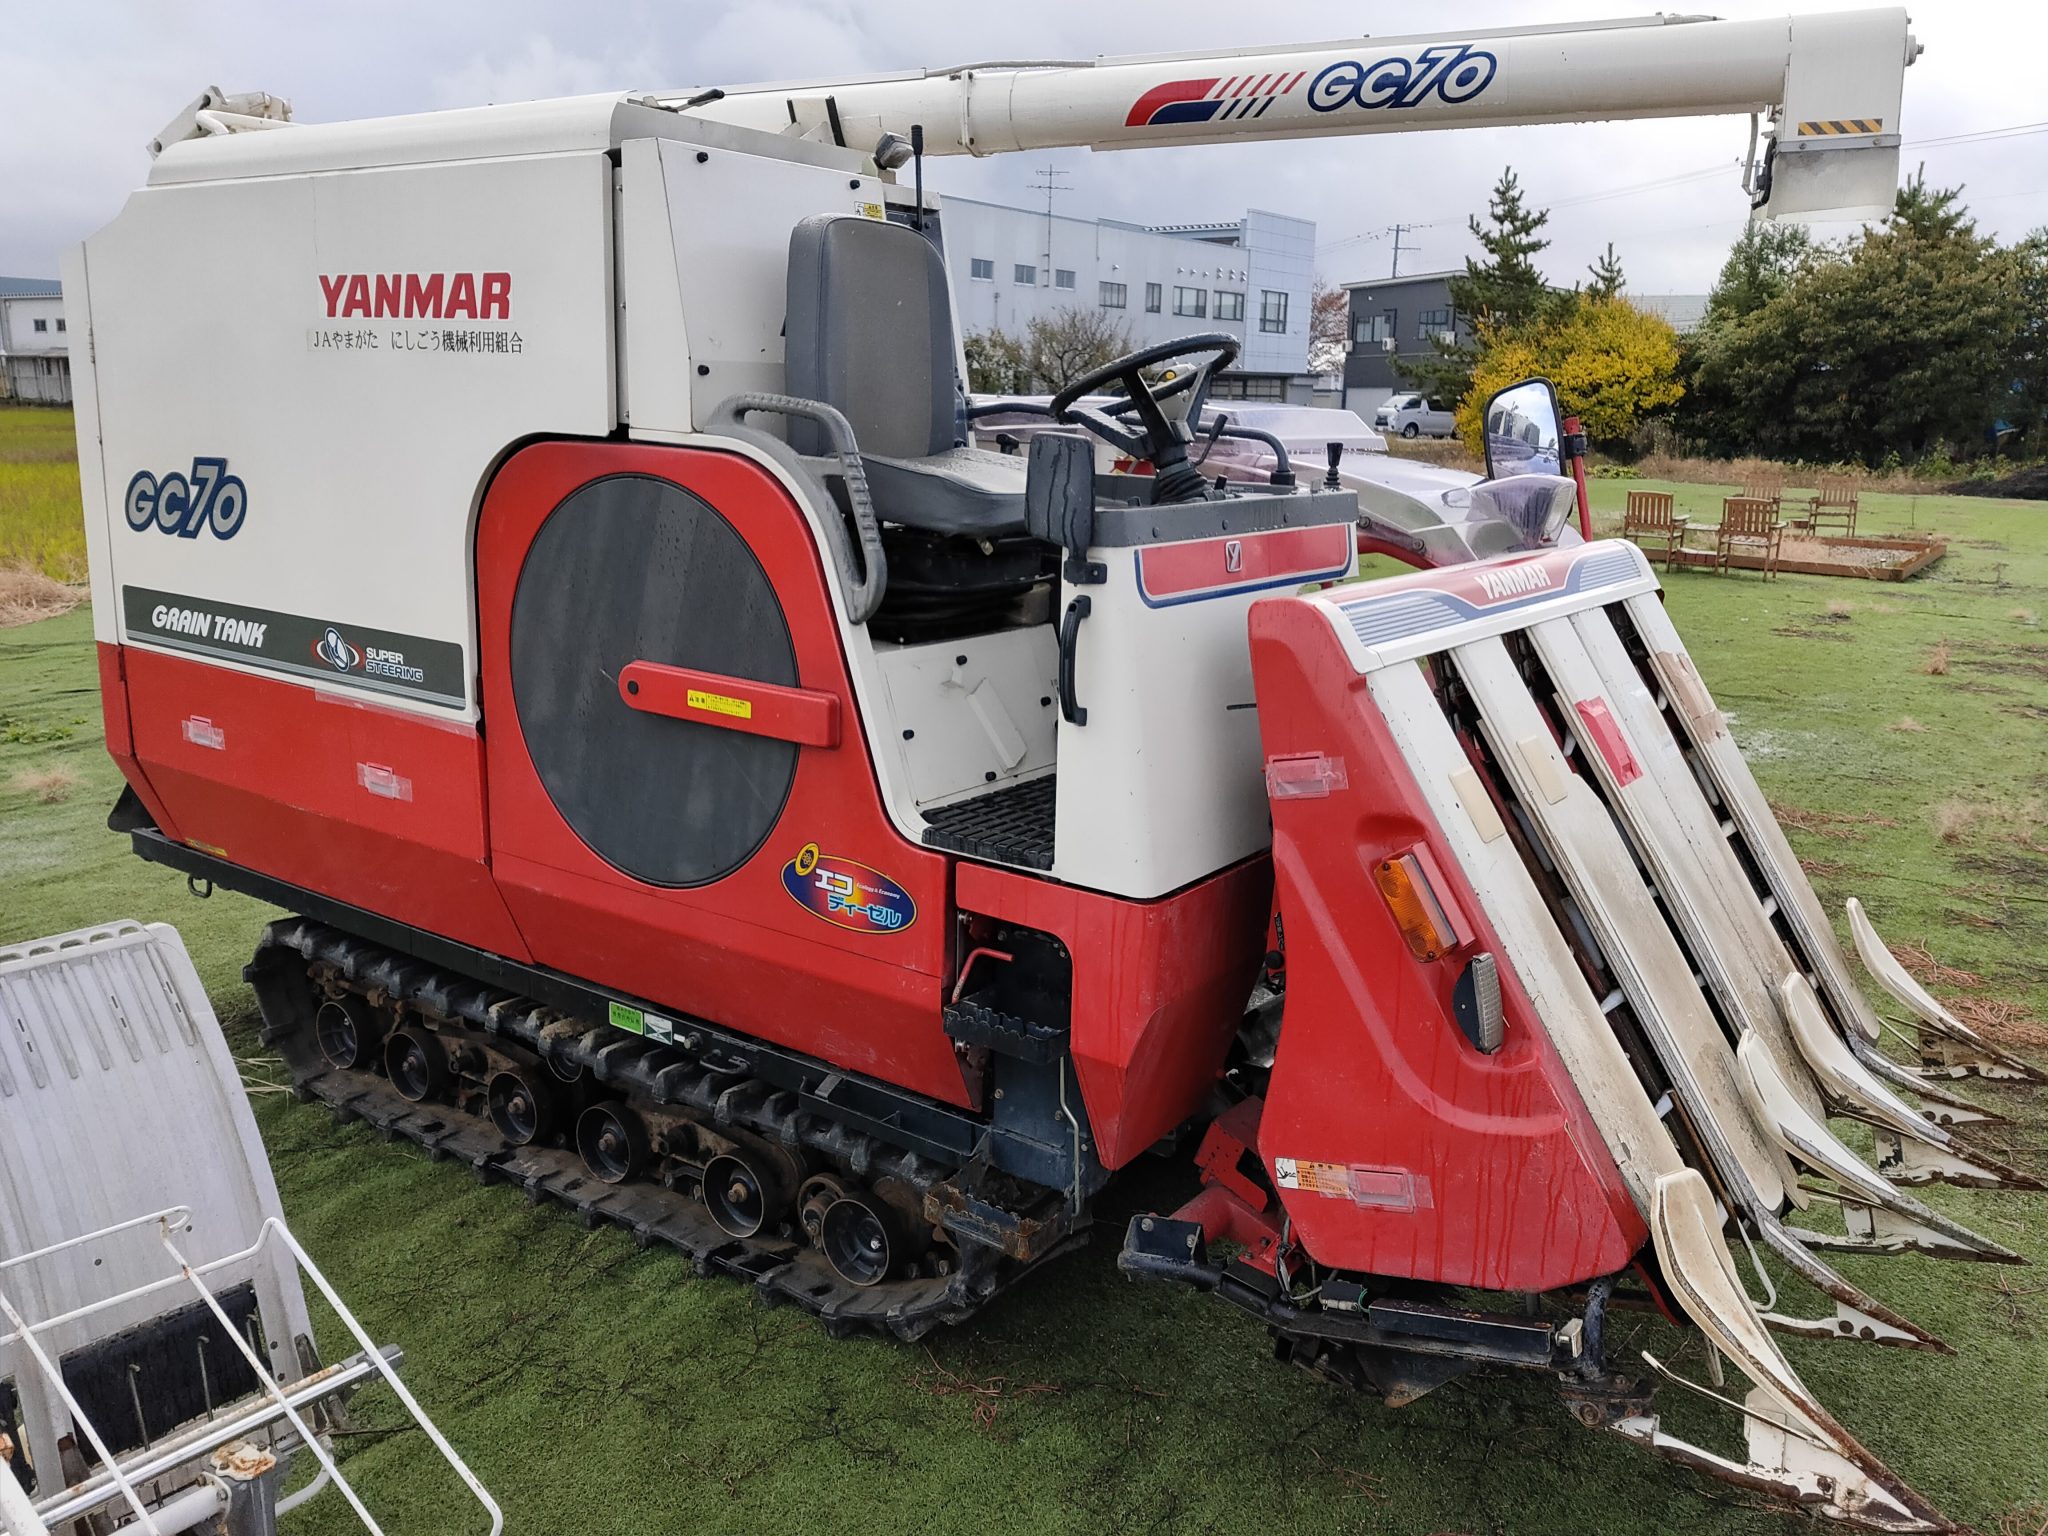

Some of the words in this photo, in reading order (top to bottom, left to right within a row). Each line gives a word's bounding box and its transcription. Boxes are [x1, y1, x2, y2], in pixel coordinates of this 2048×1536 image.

[1307, 44, 1498, 113] GC70
[319, 272, 512, 320] YANMAR
[313, 329, 379, 350] JAやまがた
[390, 329, 524, 354] にしごう機械利用組合
[124, 456, 248, 541] GC70
[1473, 563, 1552, 600] YANMAR
[151, 604, 212, 638] GRAIN
[213, 615, 268, 649] TANK
[365, 659, 424, 683] STEERING
[366, 647, 404, 665] SUPER
[814, 867, 854, 897] エコ
[828, 892, 902, 928] ディーゼル
